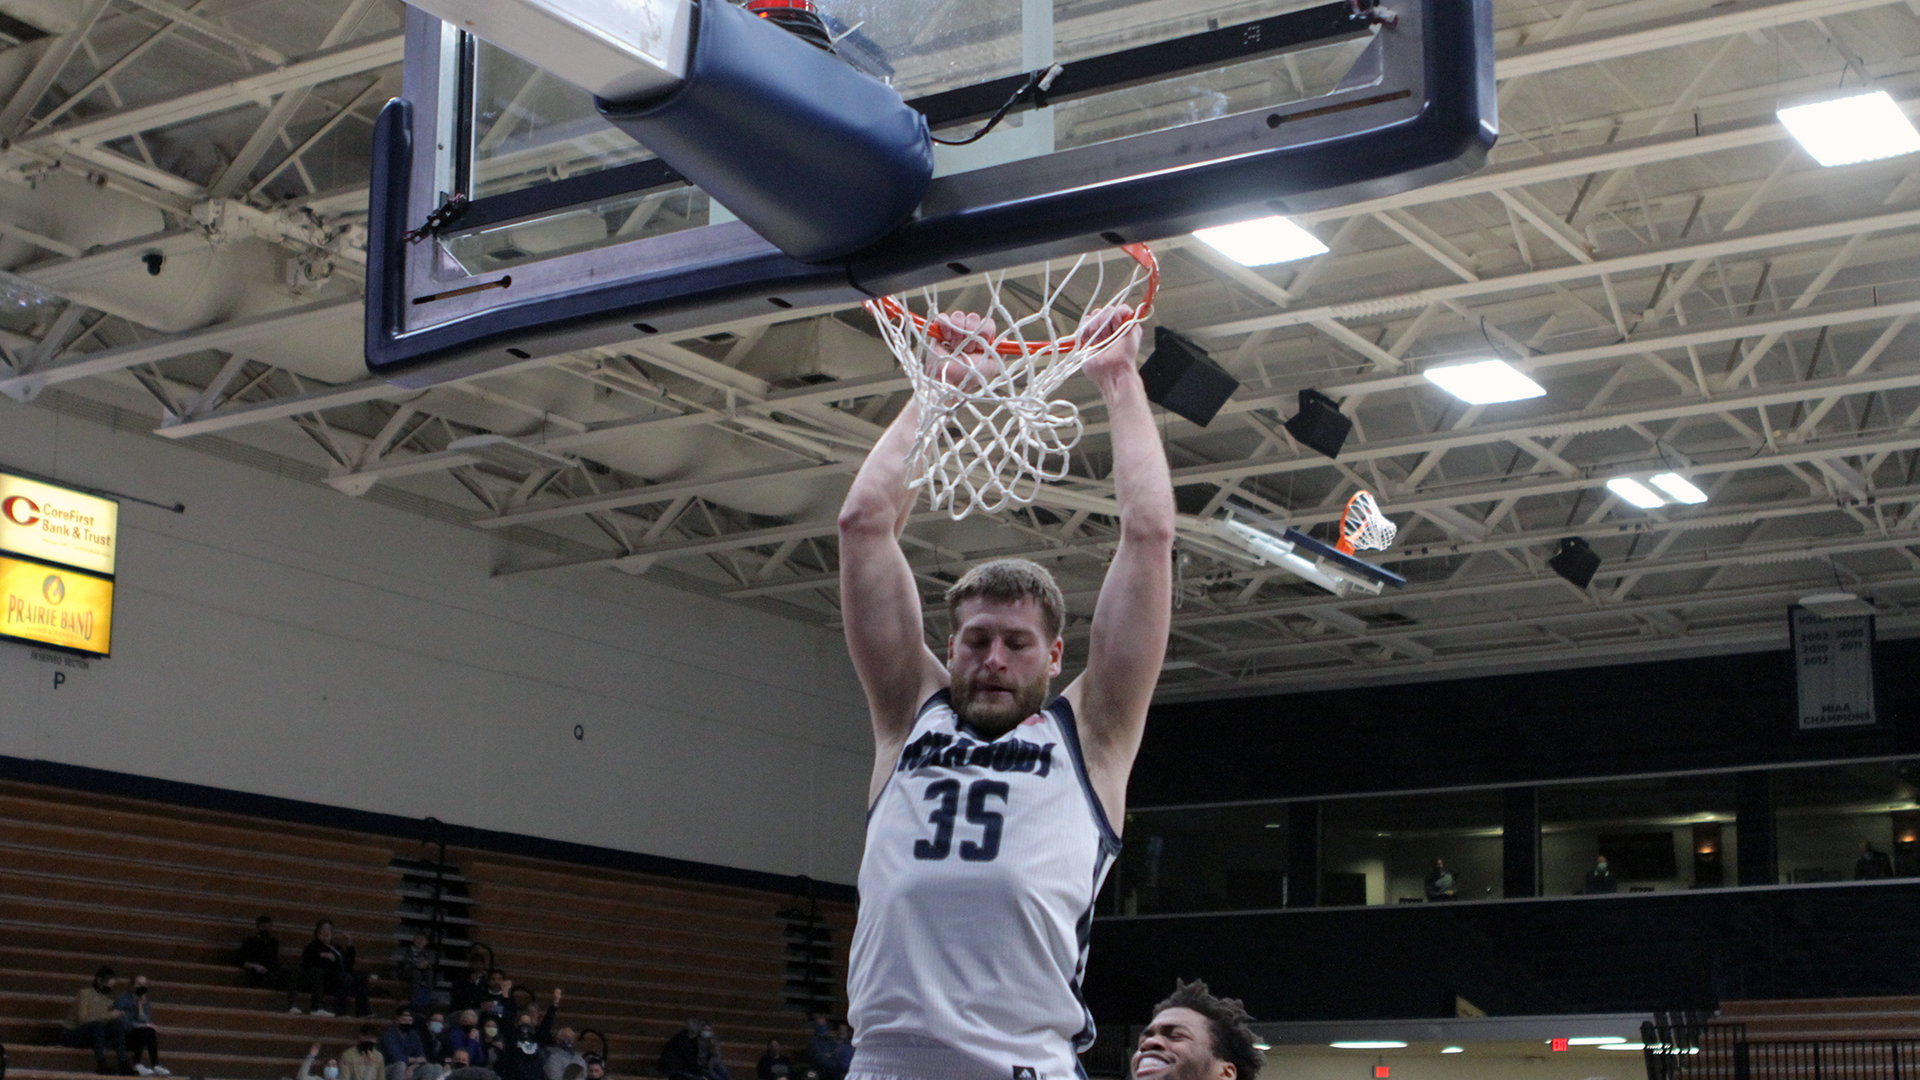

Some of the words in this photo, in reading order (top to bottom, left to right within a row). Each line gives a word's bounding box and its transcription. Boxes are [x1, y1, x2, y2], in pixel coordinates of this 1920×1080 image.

[43, 503, 95, 527] CoreFirst
[42, 518, 70, 537] Bank
[72, 525, 81, 540] &
[84, 528, 111, 547] Trust
[7, 594, 56, 627] PRAIRIE
[61, 610, 93, 640] BAND
[53, 671, 66, 690] P
[1803, 711, 1871, 725] CHAMPIONS
[1822, 703, 1851, 714] MIAA
[574, 724, 584, 741] Q
[914, 778, 1010, 862] 35
